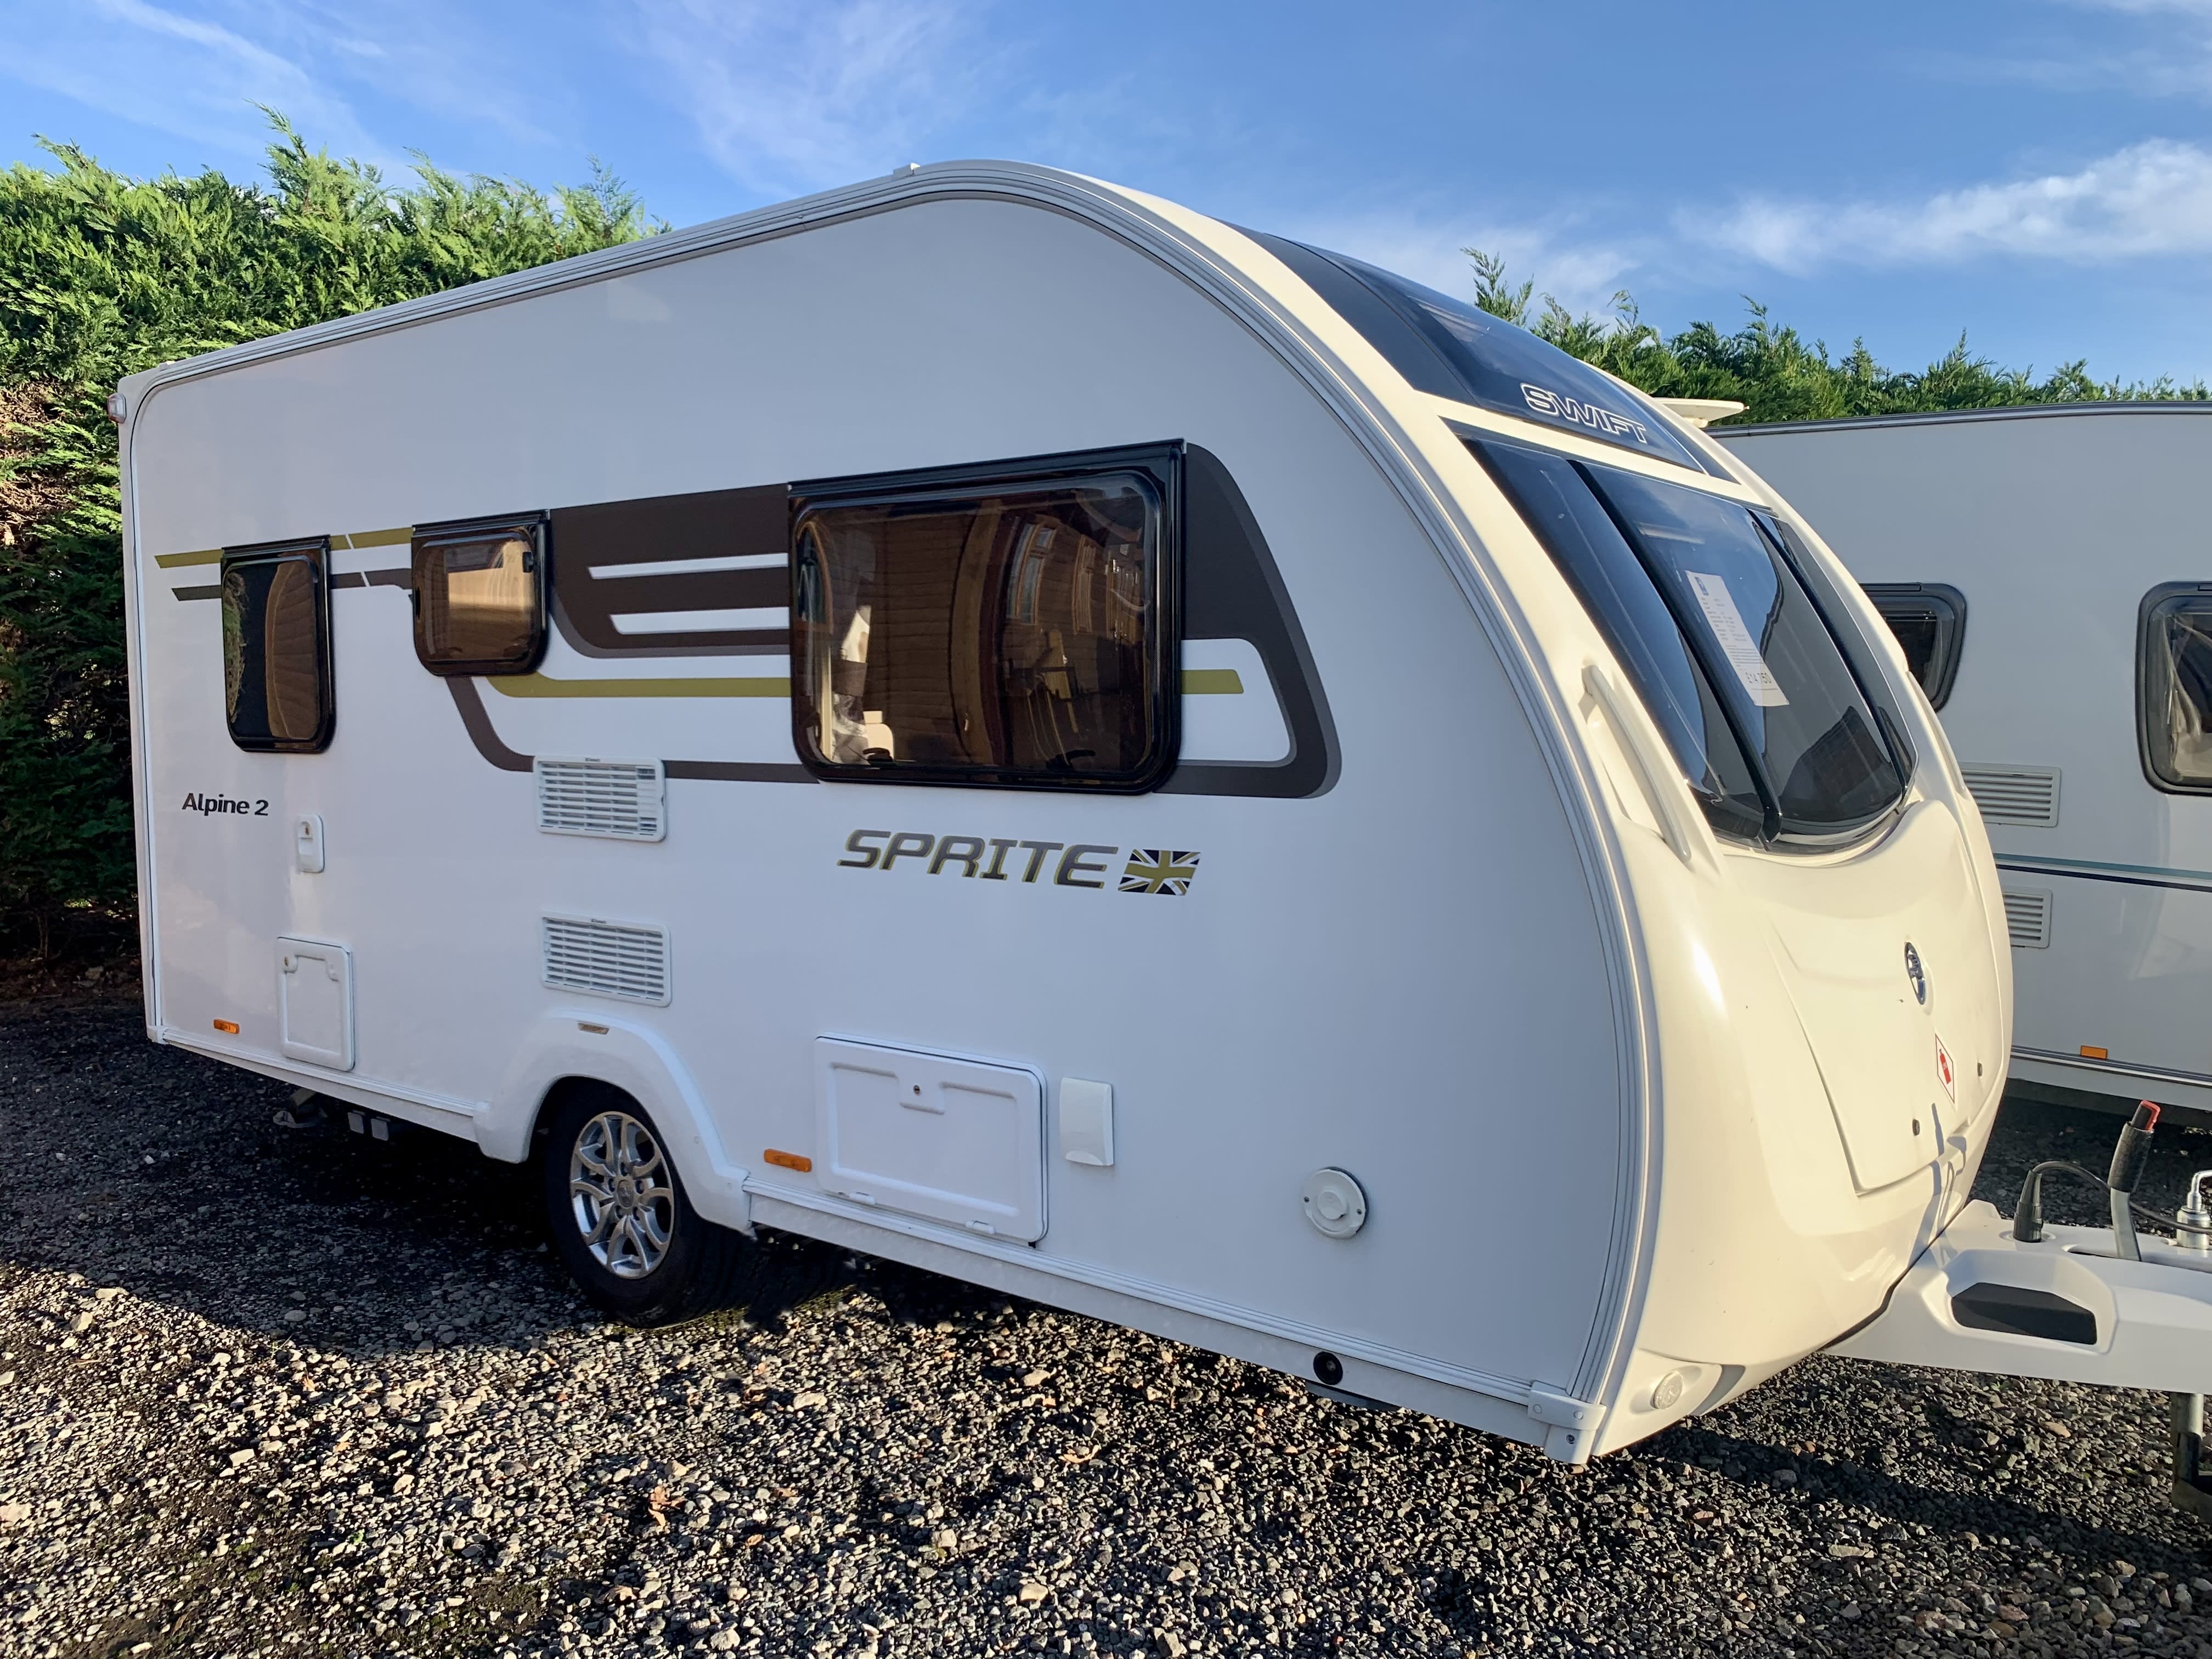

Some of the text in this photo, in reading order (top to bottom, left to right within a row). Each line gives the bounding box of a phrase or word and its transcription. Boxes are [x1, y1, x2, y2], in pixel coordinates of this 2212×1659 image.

[1520, 383, 1647, 444] SWIFT
[182, 793, 269, 816] Alpine 2
[837, 829, 1119, 889] SPRITE
